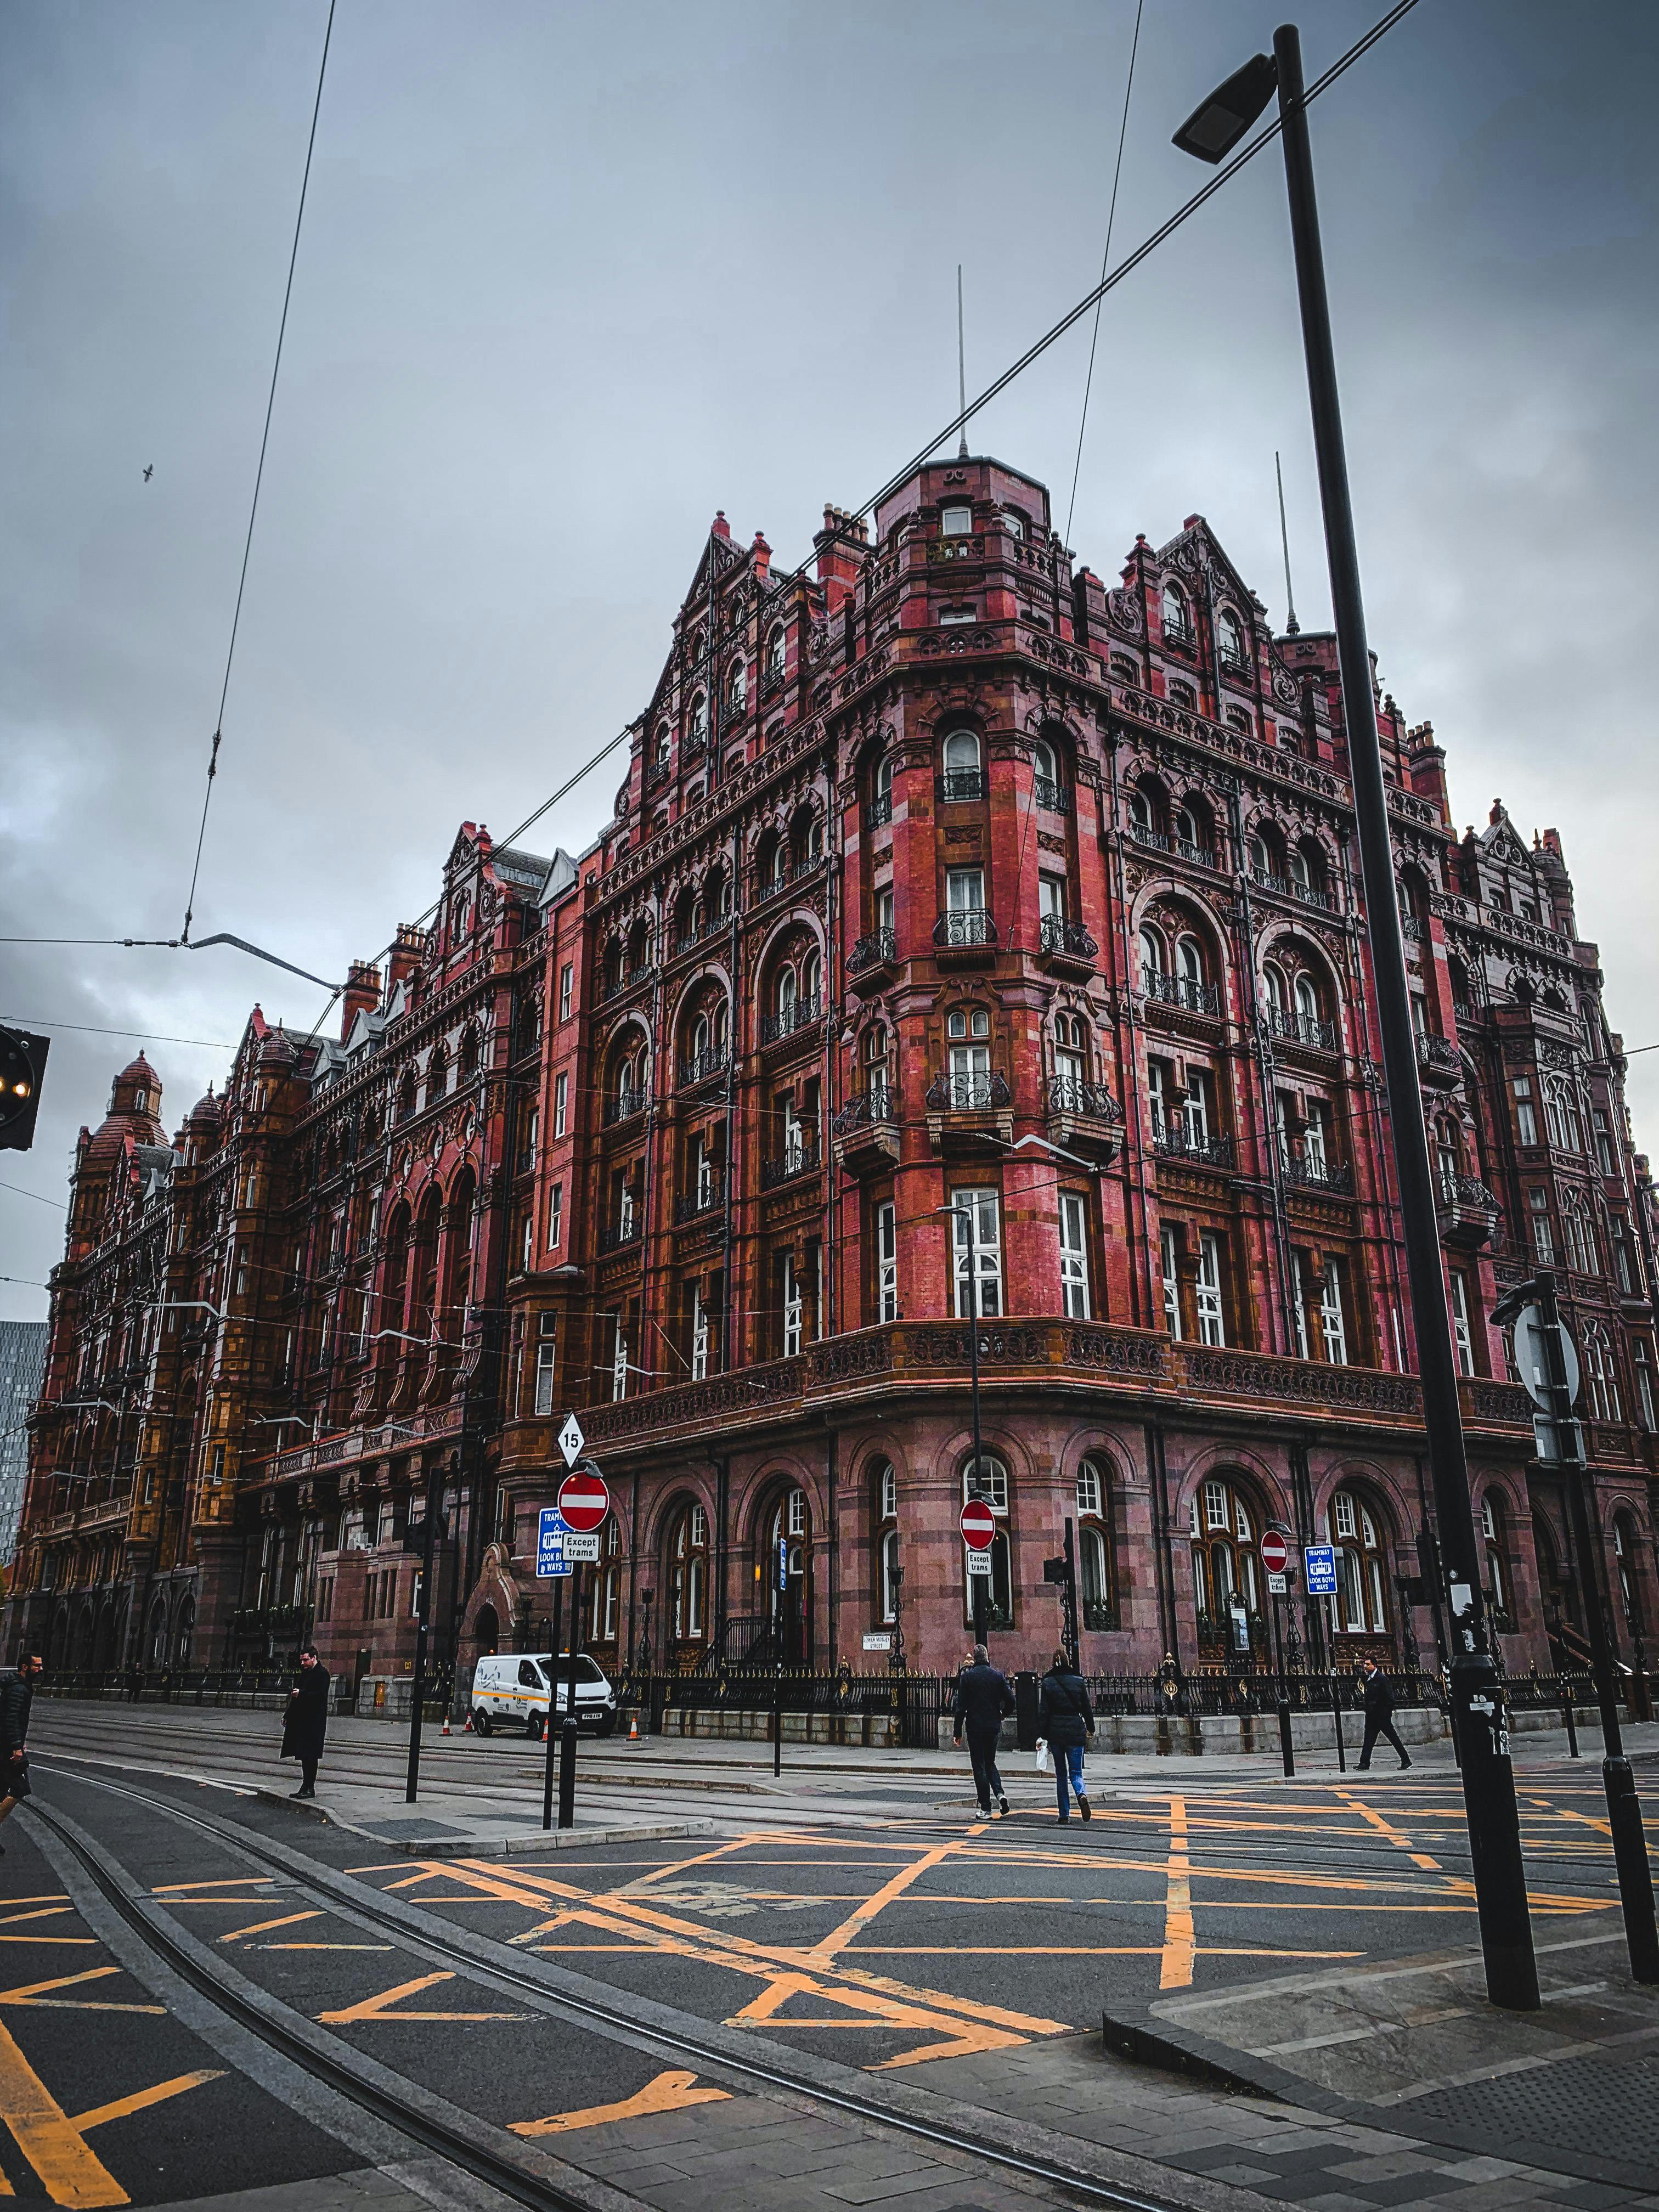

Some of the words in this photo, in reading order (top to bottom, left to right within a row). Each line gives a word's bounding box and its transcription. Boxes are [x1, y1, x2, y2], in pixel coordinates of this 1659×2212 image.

[564, 1432, 579, 1448] 15
[544, 1513, 563, 1522] TRAM
[567, 1537, 596, 1548] Except
[569, 1548, 593, 1556] trams
[539, 1553, 555, 1562] LOOK
[969, 1555, 989, 1564] Except
[547, 1562, 562, 1572] WAYS
